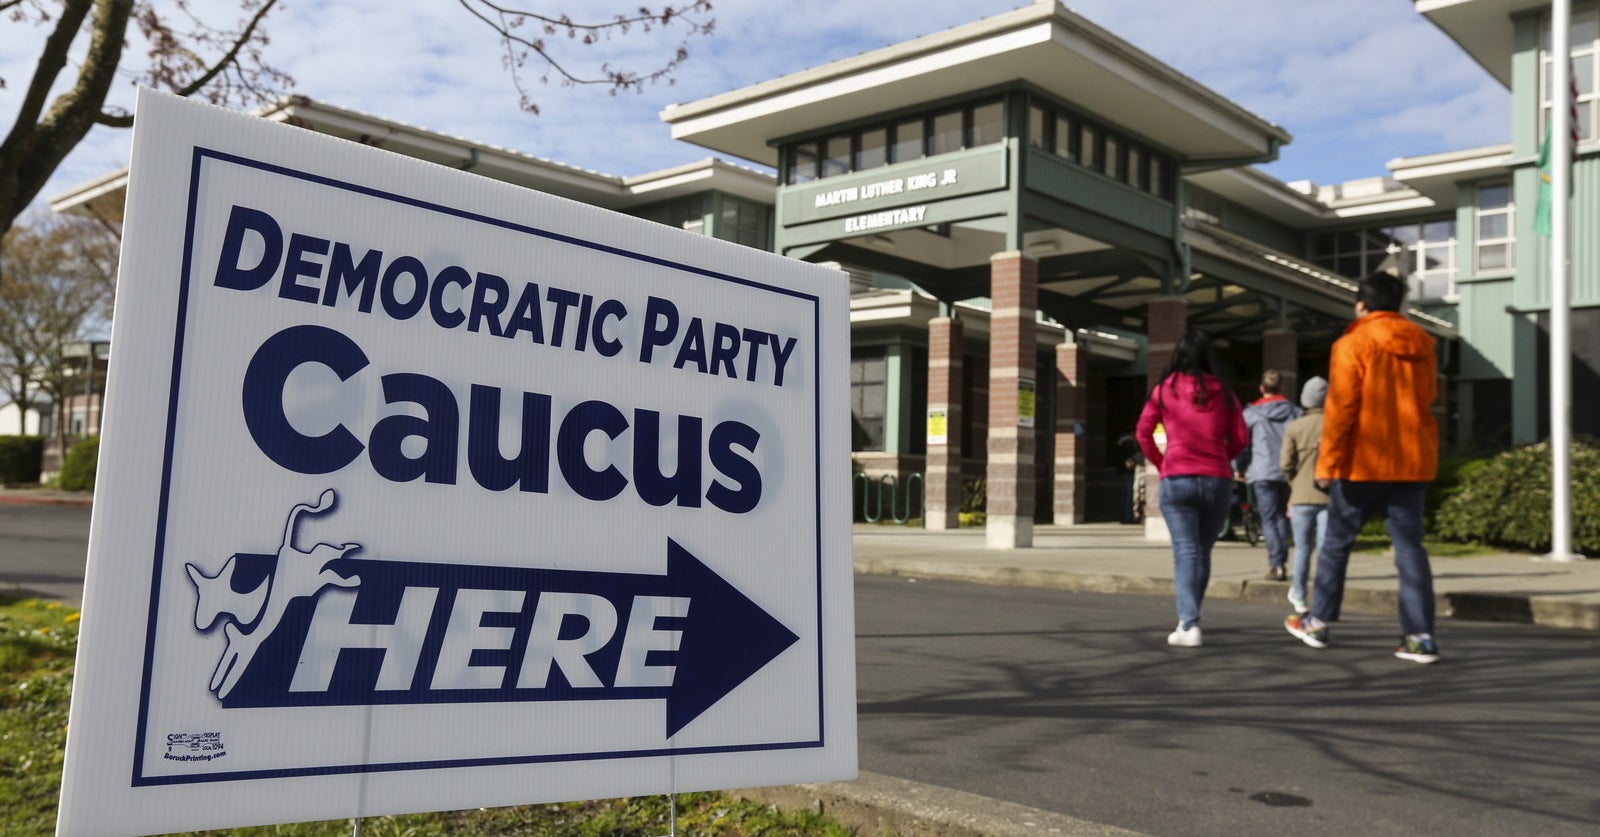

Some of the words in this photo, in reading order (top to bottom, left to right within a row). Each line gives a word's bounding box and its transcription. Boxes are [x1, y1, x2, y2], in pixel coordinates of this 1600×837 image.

[815, 186, 859, 208] MARTIN
[861, 179, 904, 199] LUTHER
[907, 172, 937, 191] KING
[940, 169, 958, 186] JR
[845, 206, 927, 233] ELEMENTARY
[242, 324, 763, 515] Caucus
[288, 586, 691, 692] HERE
